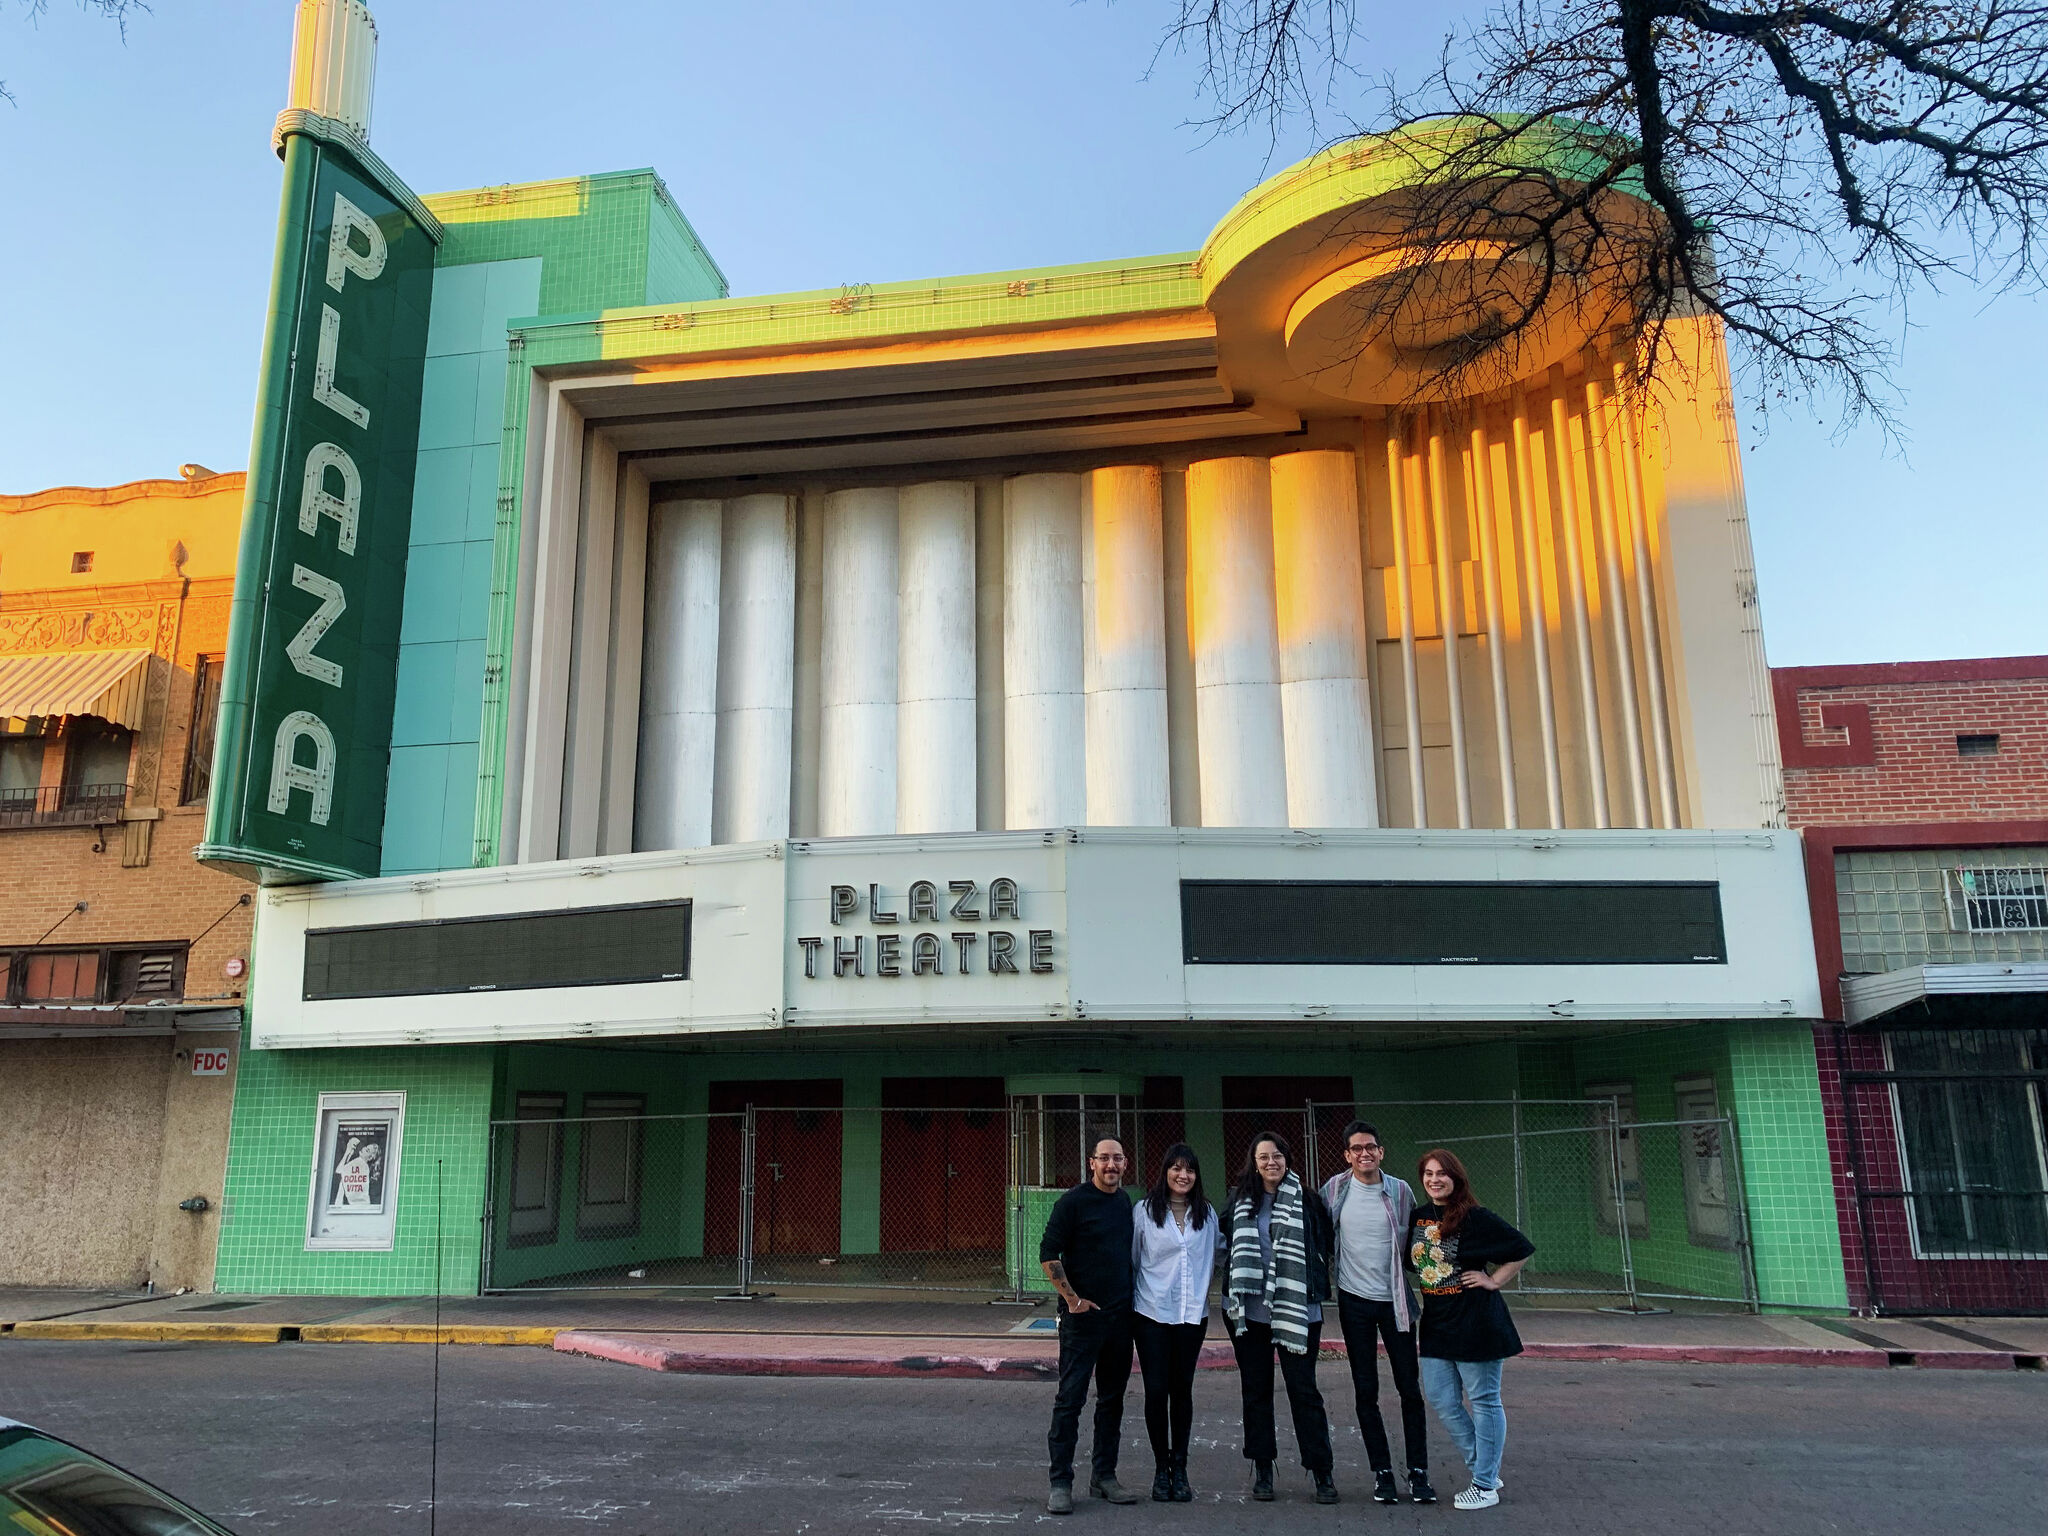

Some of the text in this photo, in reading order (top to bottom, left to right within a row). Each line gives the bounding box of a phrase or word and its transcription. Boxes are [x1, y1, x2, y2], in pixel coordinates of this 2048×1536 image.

[267, 192, 387, 826] PLAZA
[830, 877, 1020, 925] PLAZA
[798, 929, 1054, 978] THEATRE
[193, 1052, 228, 1071] FDC
[344, 1175, 367, 1183] DOLCE
[351, 1166, 360, 1174] LA
[347, 1184, 363, 1192] VITA
